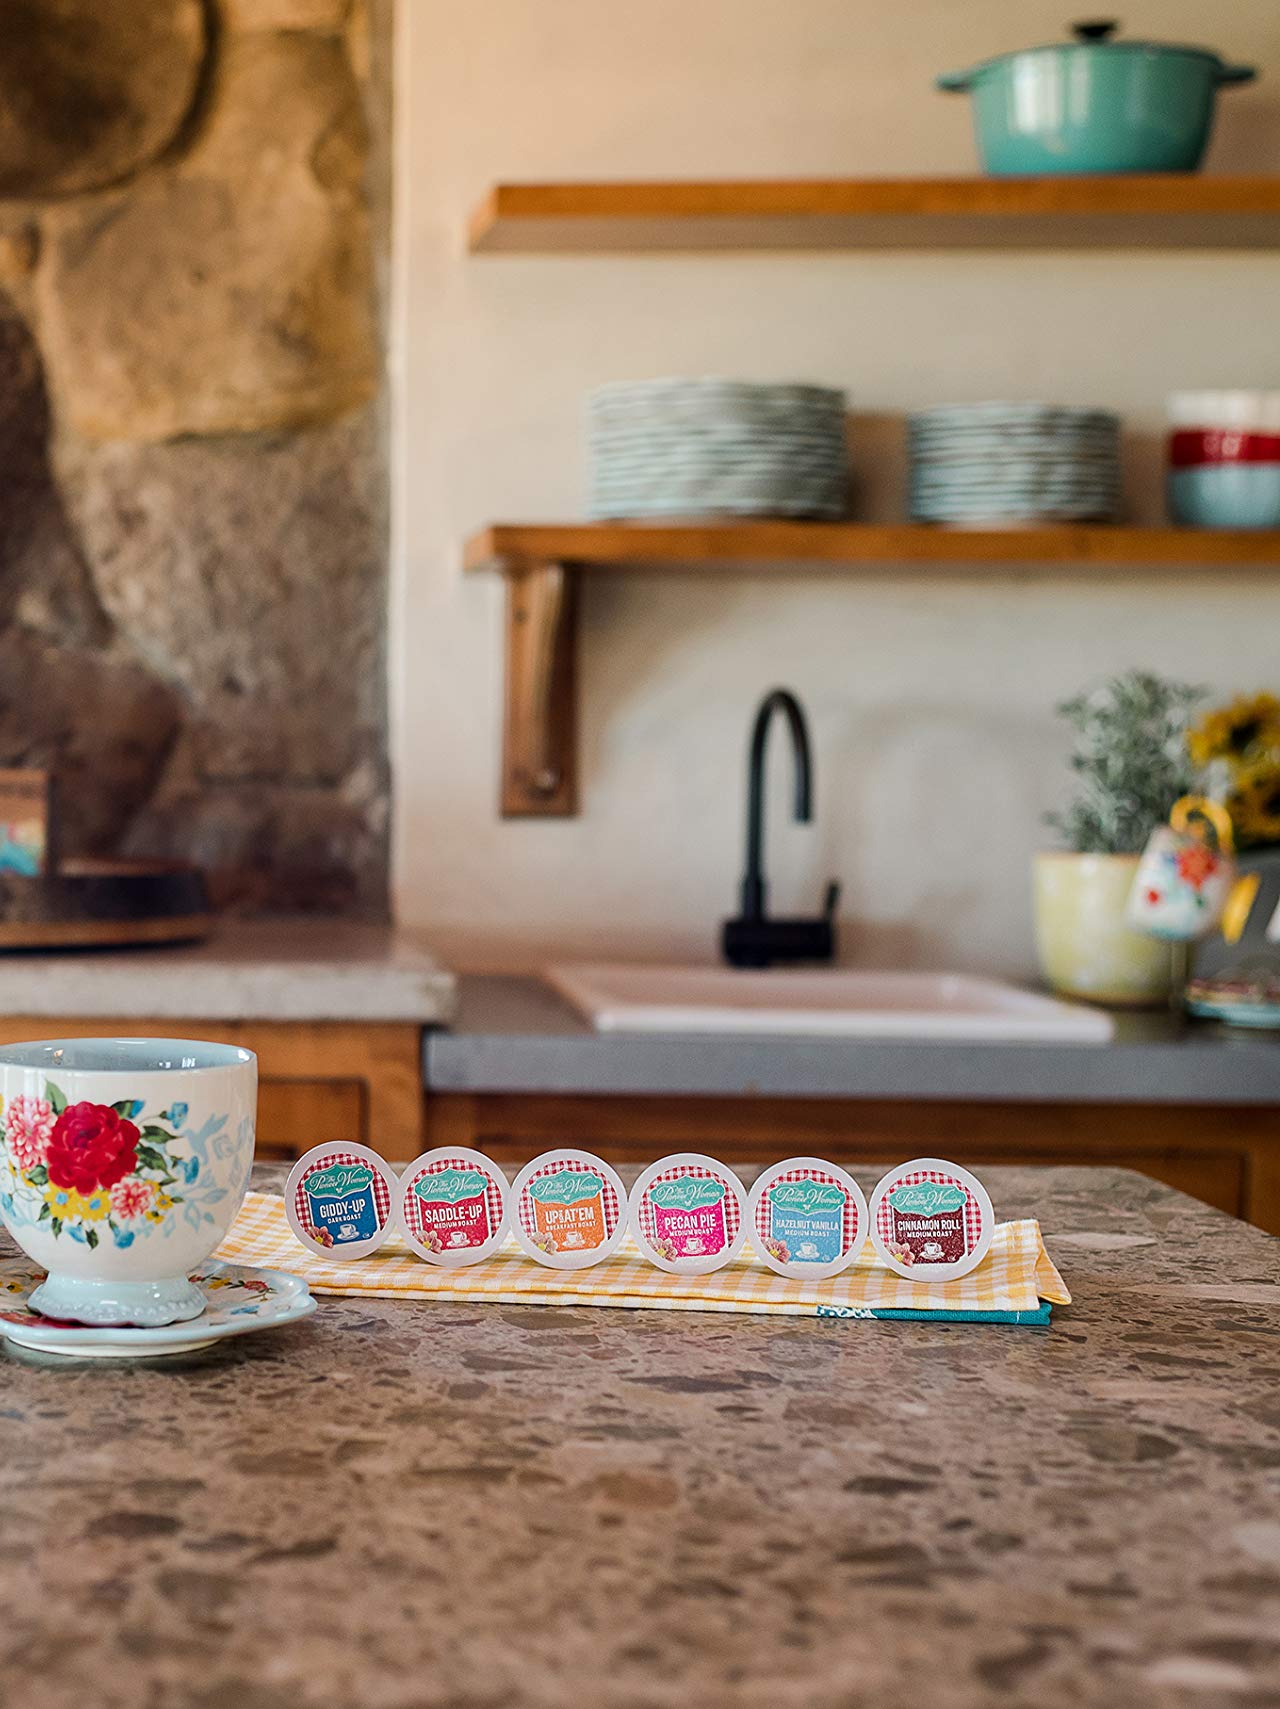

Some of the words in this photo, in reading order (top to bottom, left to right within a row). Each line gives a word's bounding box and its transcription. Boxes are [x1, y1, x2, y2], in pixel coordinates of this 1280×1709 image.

[338, 1168, 368, 1186] Woman
[320, 1199, 365, 1218] GIDDY-UP
[425, 1205, 482, 1223] SADDLE-UP
[328, 1216, 342, 1224] DARK
[665, 1216, 698, 1230] PECAN
[700, 1214, 716, 1227] PIE
[776, 1220, 810, 1228] HAZELNUT
[812, 1221, 839, 1230] VANILLA
[898, 1221, 939, 1231] CINNAMON
[941, 1220, 960, 1229] ROLL
